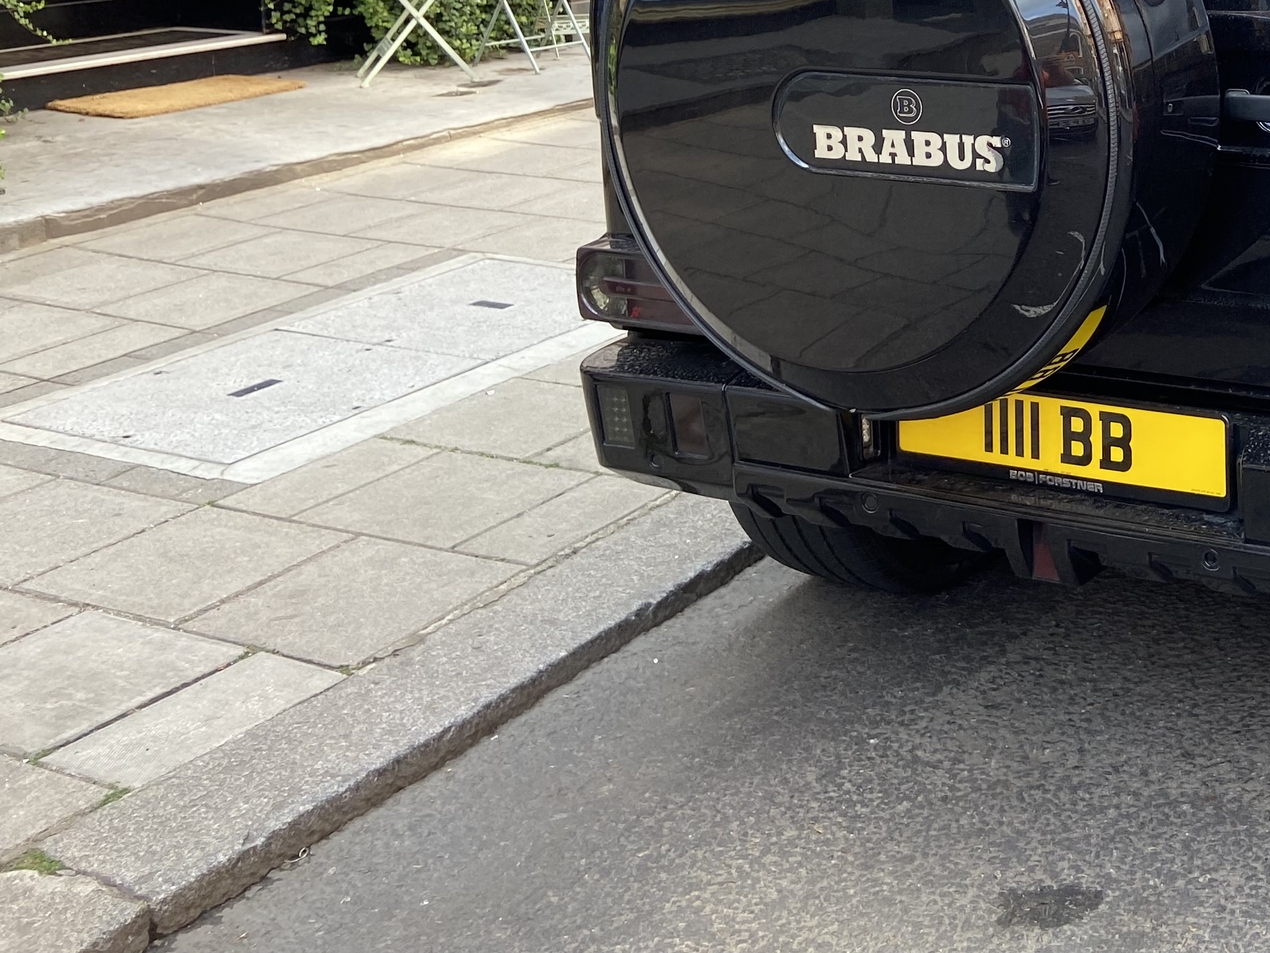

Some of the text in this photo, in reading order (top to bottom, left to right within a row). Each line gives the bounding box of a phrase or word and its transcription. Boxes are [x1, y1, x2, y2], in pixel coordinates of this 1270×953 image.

[896, 95, 917, 117] B
[812, 124, 1005, 173] BRABUS
[1060, 405, 1133, 473] BB
